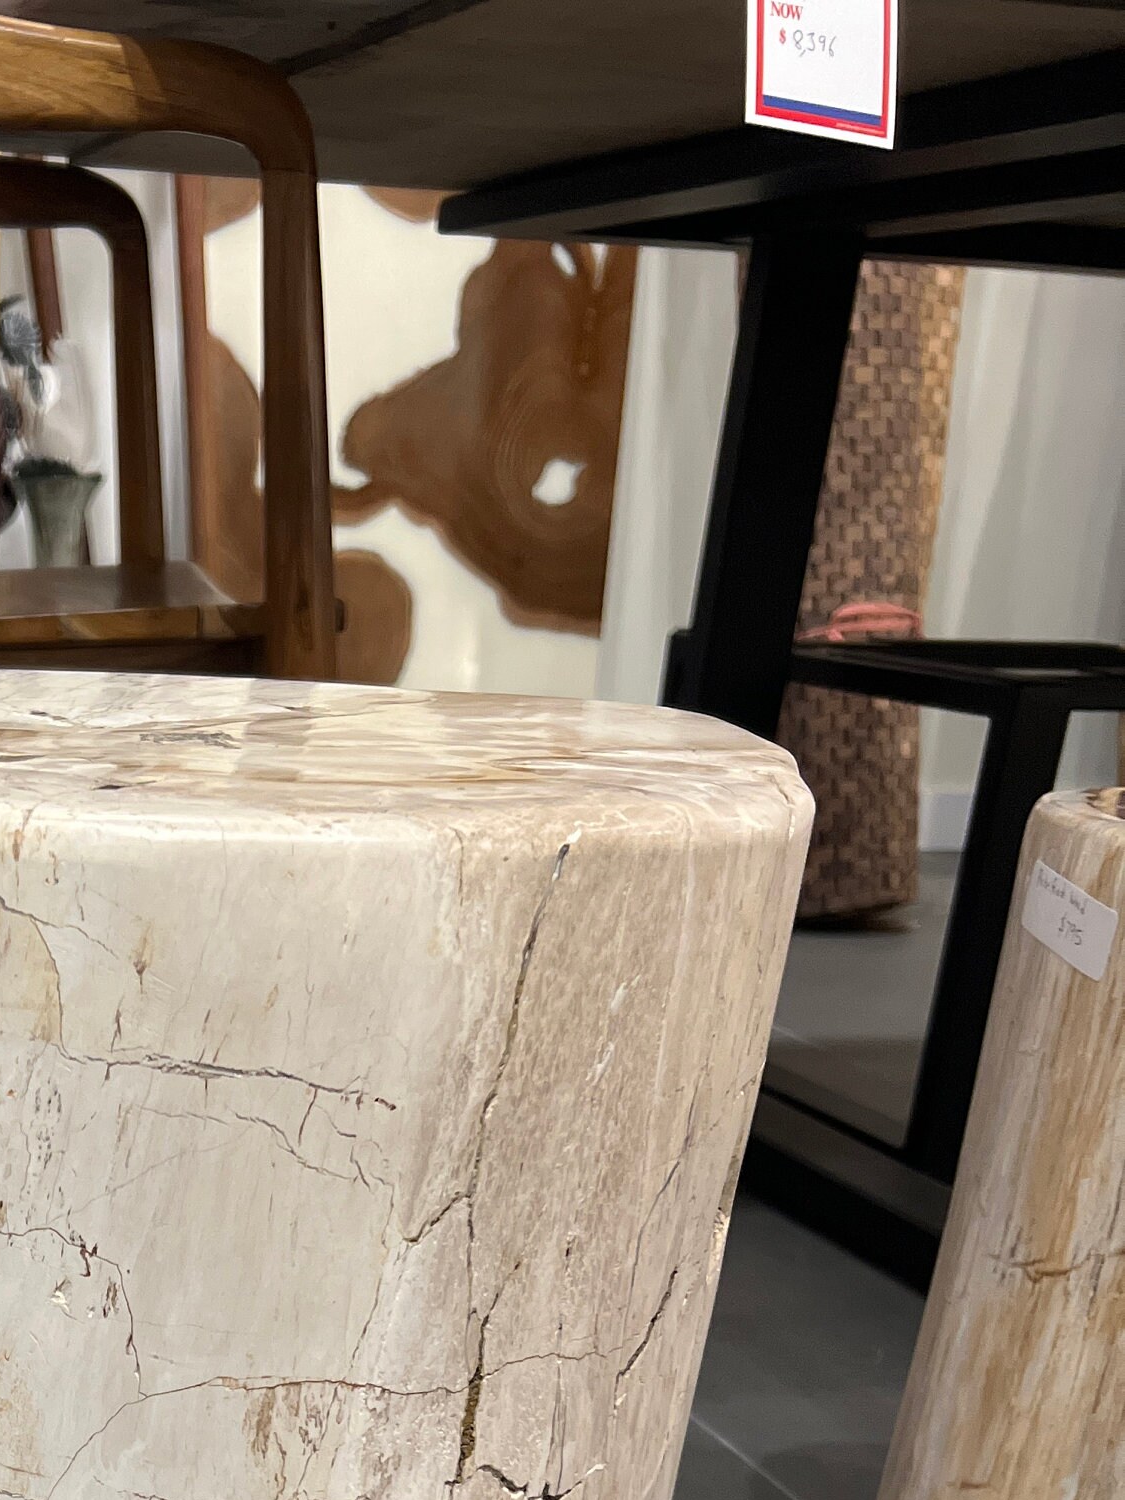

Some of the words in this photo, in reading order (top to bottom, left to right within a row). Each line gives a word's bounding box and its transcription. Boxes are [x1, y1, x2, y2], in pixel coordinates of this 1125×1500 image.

[770, 1, 803, 21] NOW
[779, 27, 787, 45] $
[793, 29, 837, 57] 8,396
